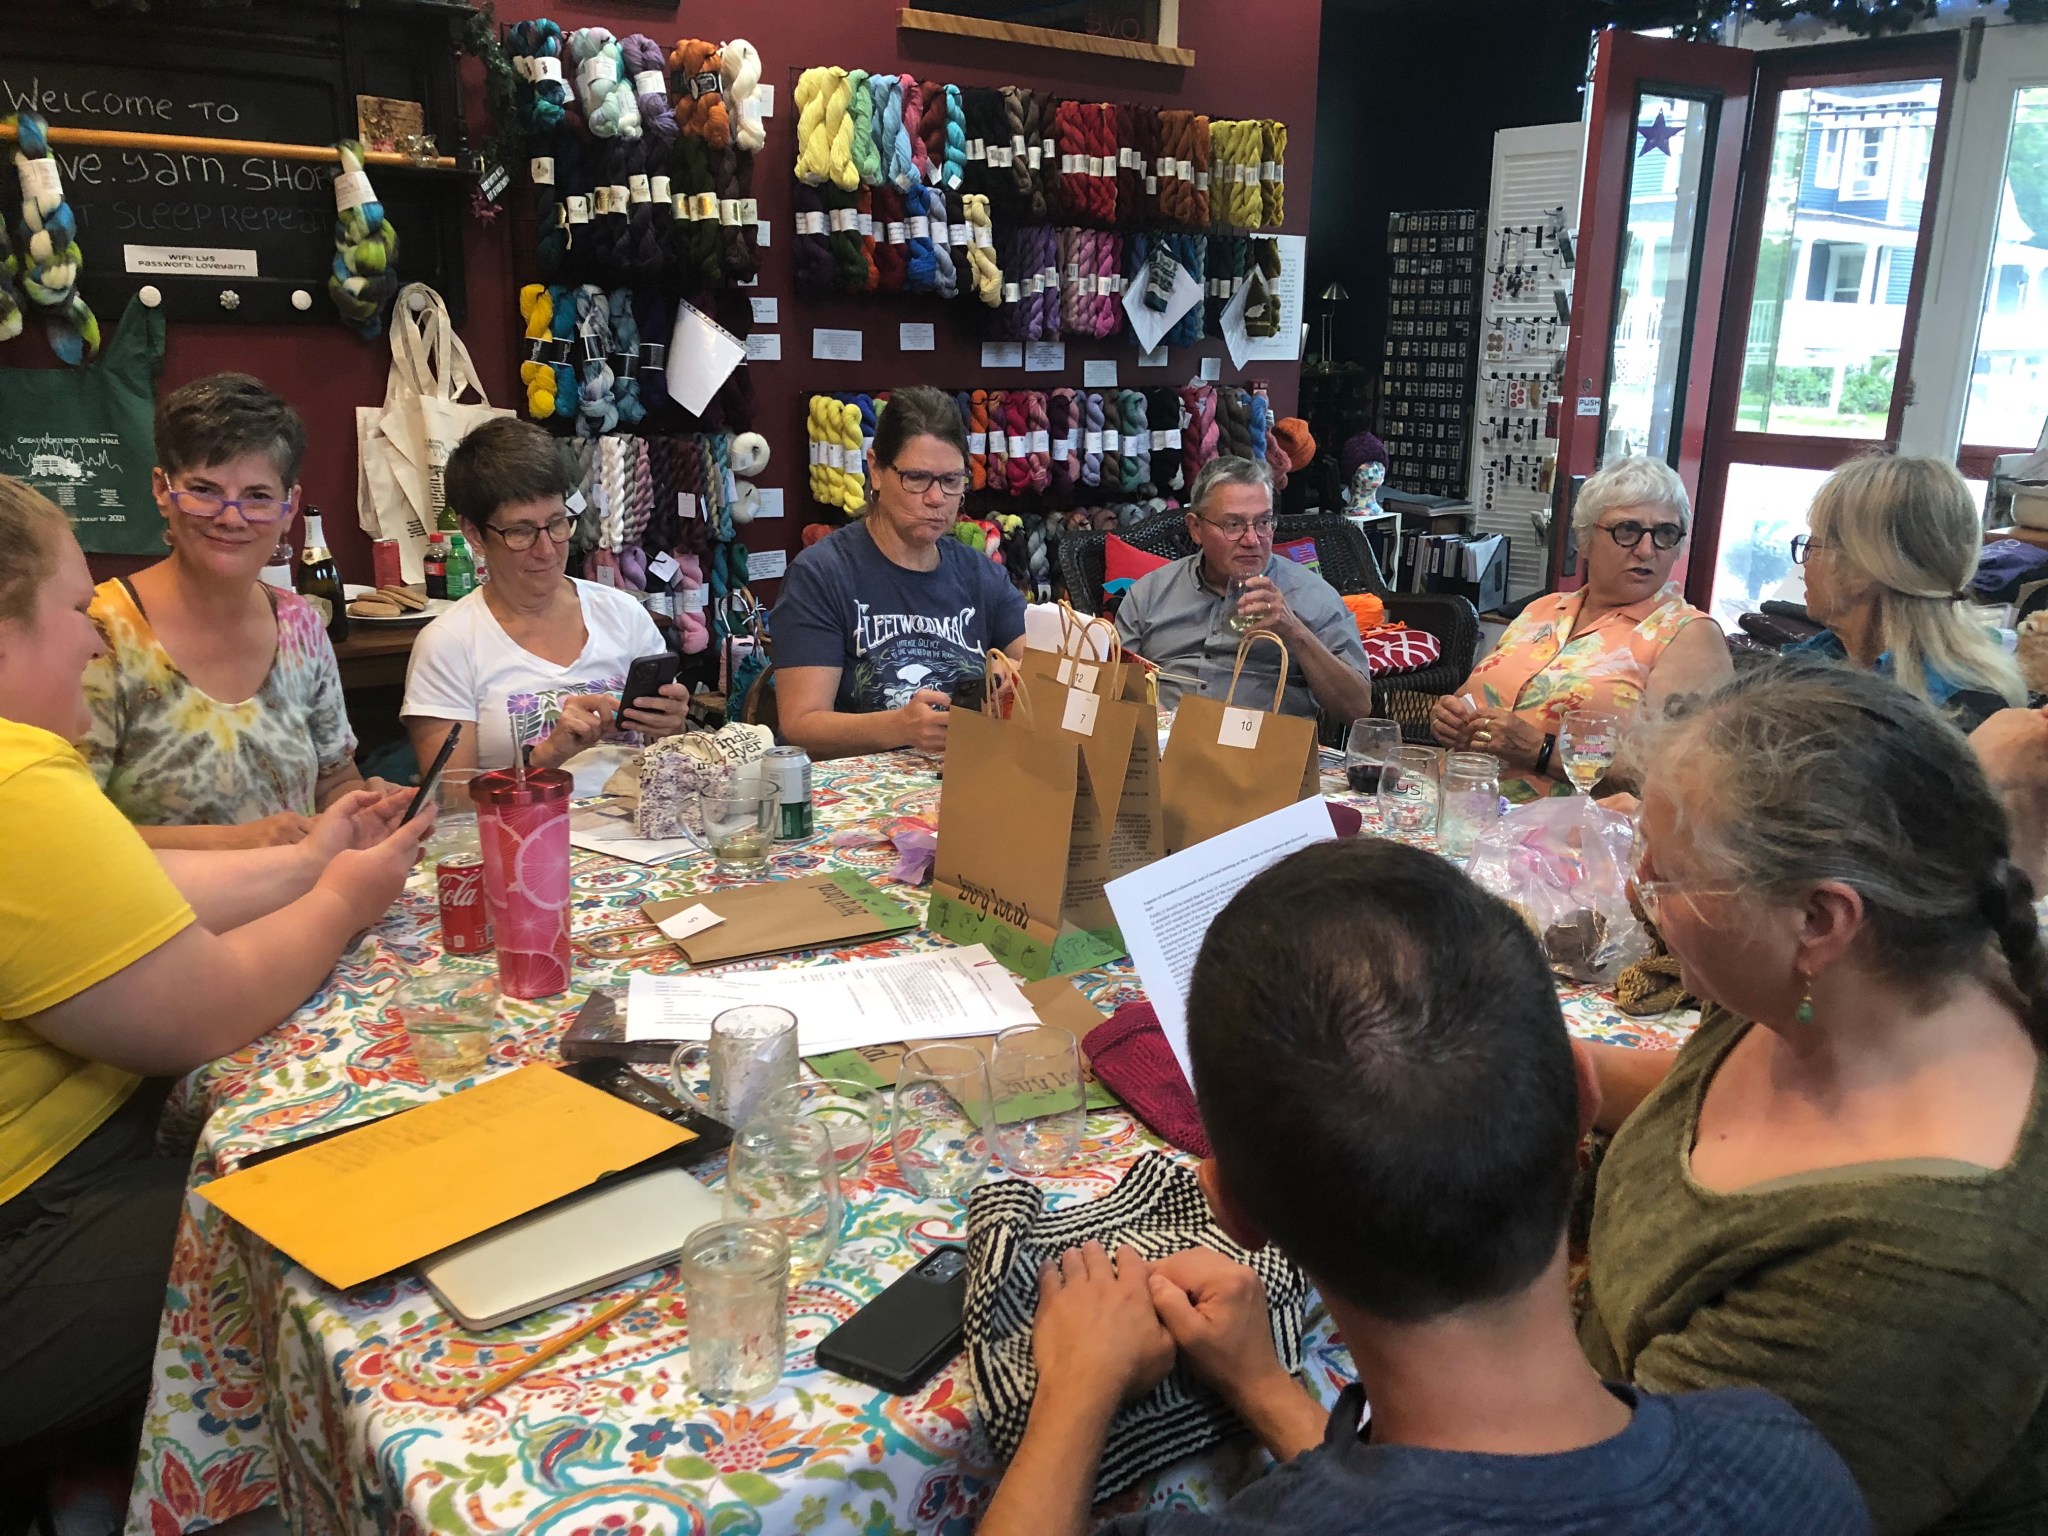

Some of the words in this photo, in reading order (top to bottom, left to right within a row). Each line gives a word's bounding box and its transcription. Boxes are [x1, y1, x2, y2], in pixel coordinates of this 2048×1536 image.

[1579, 399, 1600, 407] PUSH
[108, 514, 126, 522] 2021
[1075, 672, 1084, 683] 12
[1080, 712, 1087, 724] 7
[1241, 720, 1253, 732] 10
[716, 730, 760, 750] indie
[727, 740, 763, 760] dyer
[957, 873, 990, 922] buy
[991, 887, 1030, 931] local
